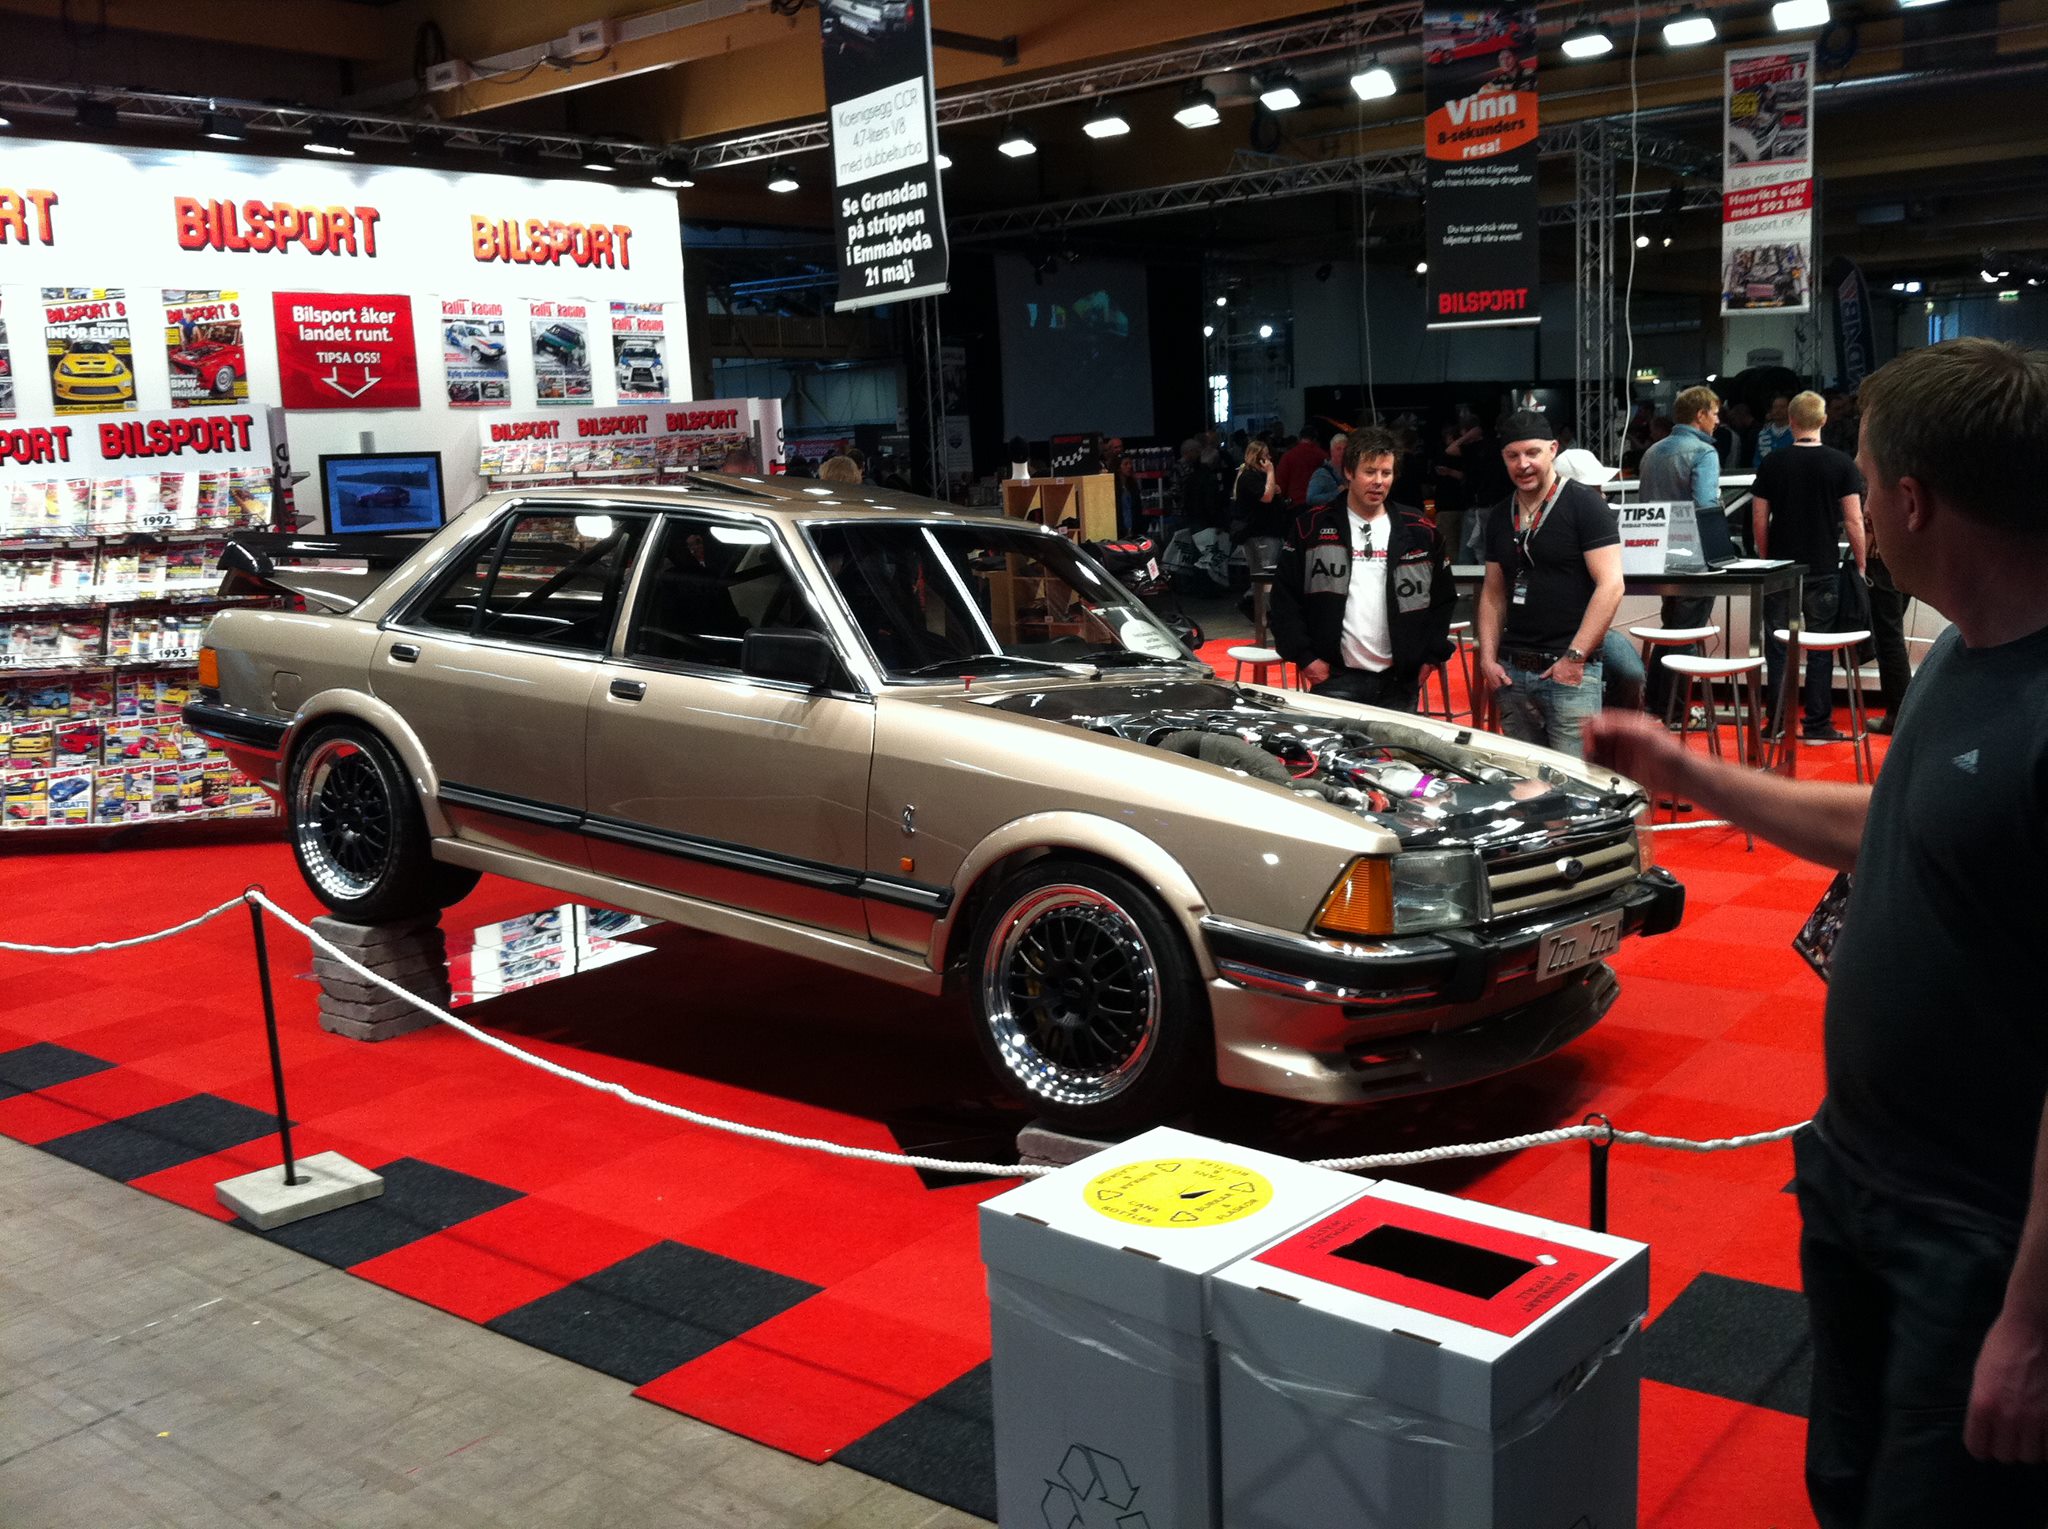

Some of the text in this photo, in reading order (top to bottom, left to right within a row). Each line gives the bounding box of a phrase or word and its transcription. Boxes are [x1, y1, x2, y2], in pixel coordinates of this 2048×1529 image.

[894, 87, 918, 110] CCR
[1445, 94, 1517, 125] Vinn
[1438, 119, 1526, 145] 8-sekunders
[1462, 138, 1501, 159] resa!
[839, 157, 863, 176] med
[842, 181, 928, 218] Se Granadan
[1728, 181, 1808, 206] Henriks Golf
[1731, 196, 1805, 218] med 592 hk
[174, 196, 380, 258] BILSPORT
[848, 207, 925, 246] på strippen
[470, 214, 632, 270] BILSPORT
[845, 232, 933, 266] i Emmaboda
[865, 259, 915, 287] 21 maj!
[1438, 287, 1528, 314] BILSPORT
[292, 305, 396, 326] Bilsport åker
[46, 324, 88, 339] INFÖR
[90, 326, 130, 339] ELMIA
[299, 324, 394, 342] landet runt.
[316, 352, 381, 364] TIPSA OSS!
[490, 420, 560, 442] BILSPORT
[577, 415, 648, 437] BILSPORT
[666, 409, 738, 432] BILSPORT
[98, 414, 254, 460] BILSPORT
[142, 515, 172, 526] 1992
[1623, 507, 1666, 521] TIPSA
[1311, 558, 1346, 578] Au
[159, 649, 187, 659] 1993
[1129, 1200, 1159, 1212] CANS
[1195, 1193, 1233, 1212] BURKAR
[1216, 1199, 1258, 1221] FLASKOR
[1102, 1205, 1152, 1224] BOTTLES
